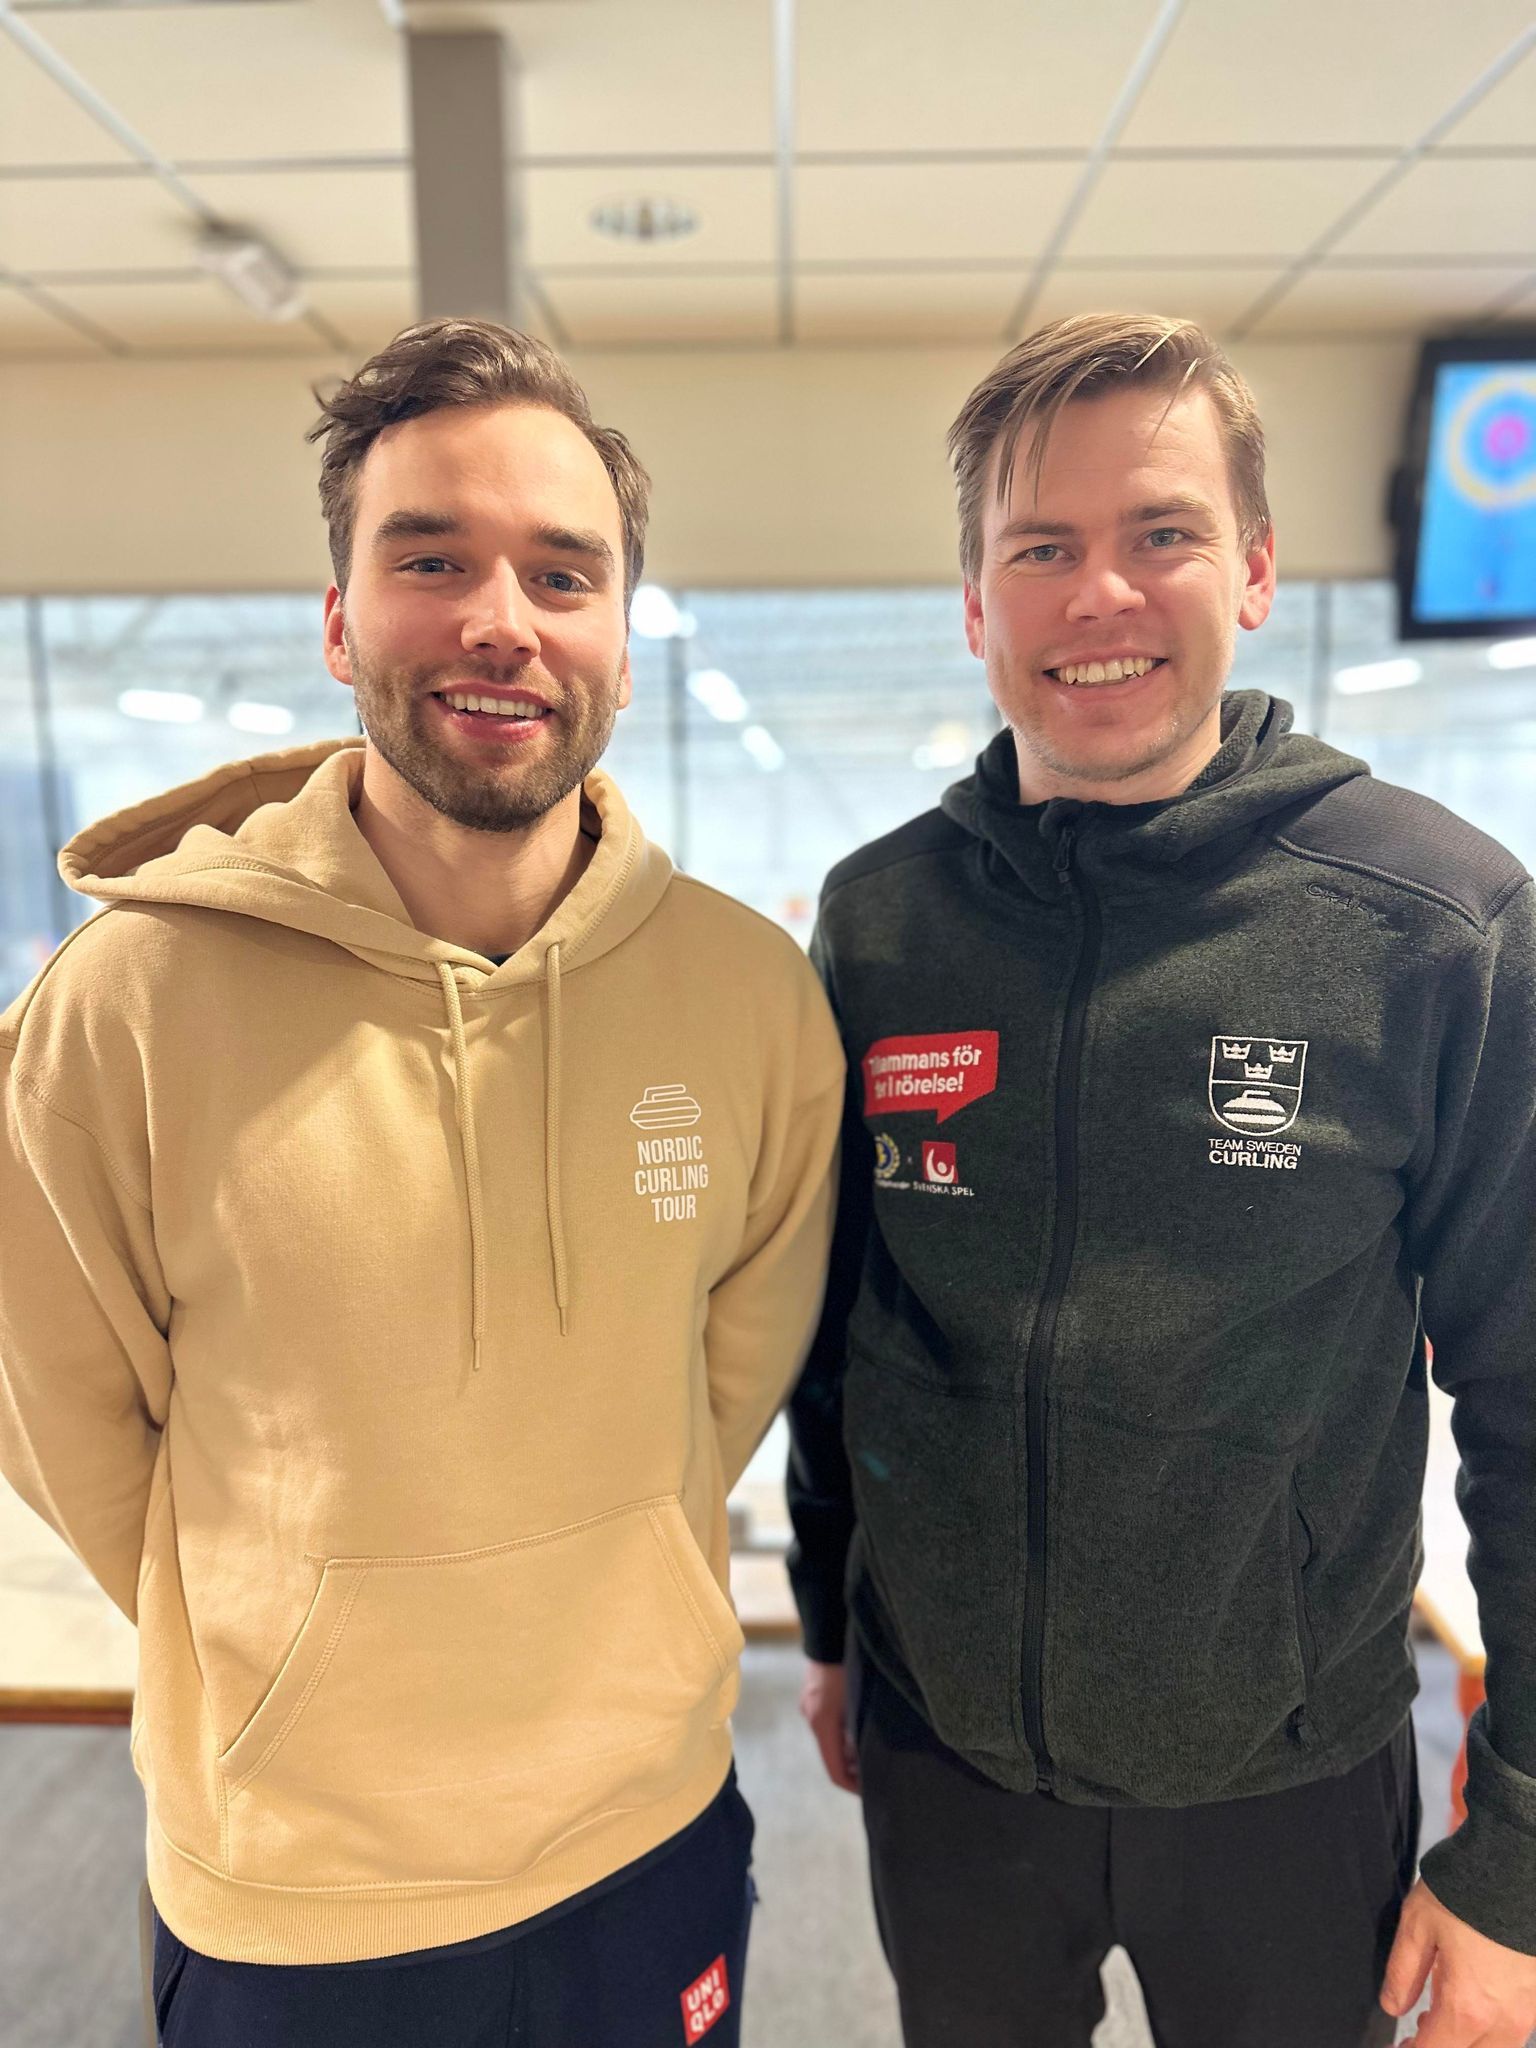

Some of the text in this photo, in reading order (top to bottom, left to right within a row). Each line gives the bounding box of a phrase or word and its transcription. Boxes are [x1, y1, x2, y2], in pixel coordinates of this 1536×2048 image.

[952, 1044, 982, 1067] för
[895, 1071, 964, 1096] rörelse!
[637, 1135, 703, 1166] NORDIC
[1208, 1138, 1301, 1157] TEAM SWEDEN
[1208, 1149, 1298, 1170] CURLING
[634, 1163, 709, 1196] CURLING
[951, 1187, 975, 1197] SPEL
[651, 1194, 696, 1223] TOUR
[686, 1967, 720, 2012] UNI
[690, 1987, 725, 2033] QLO
